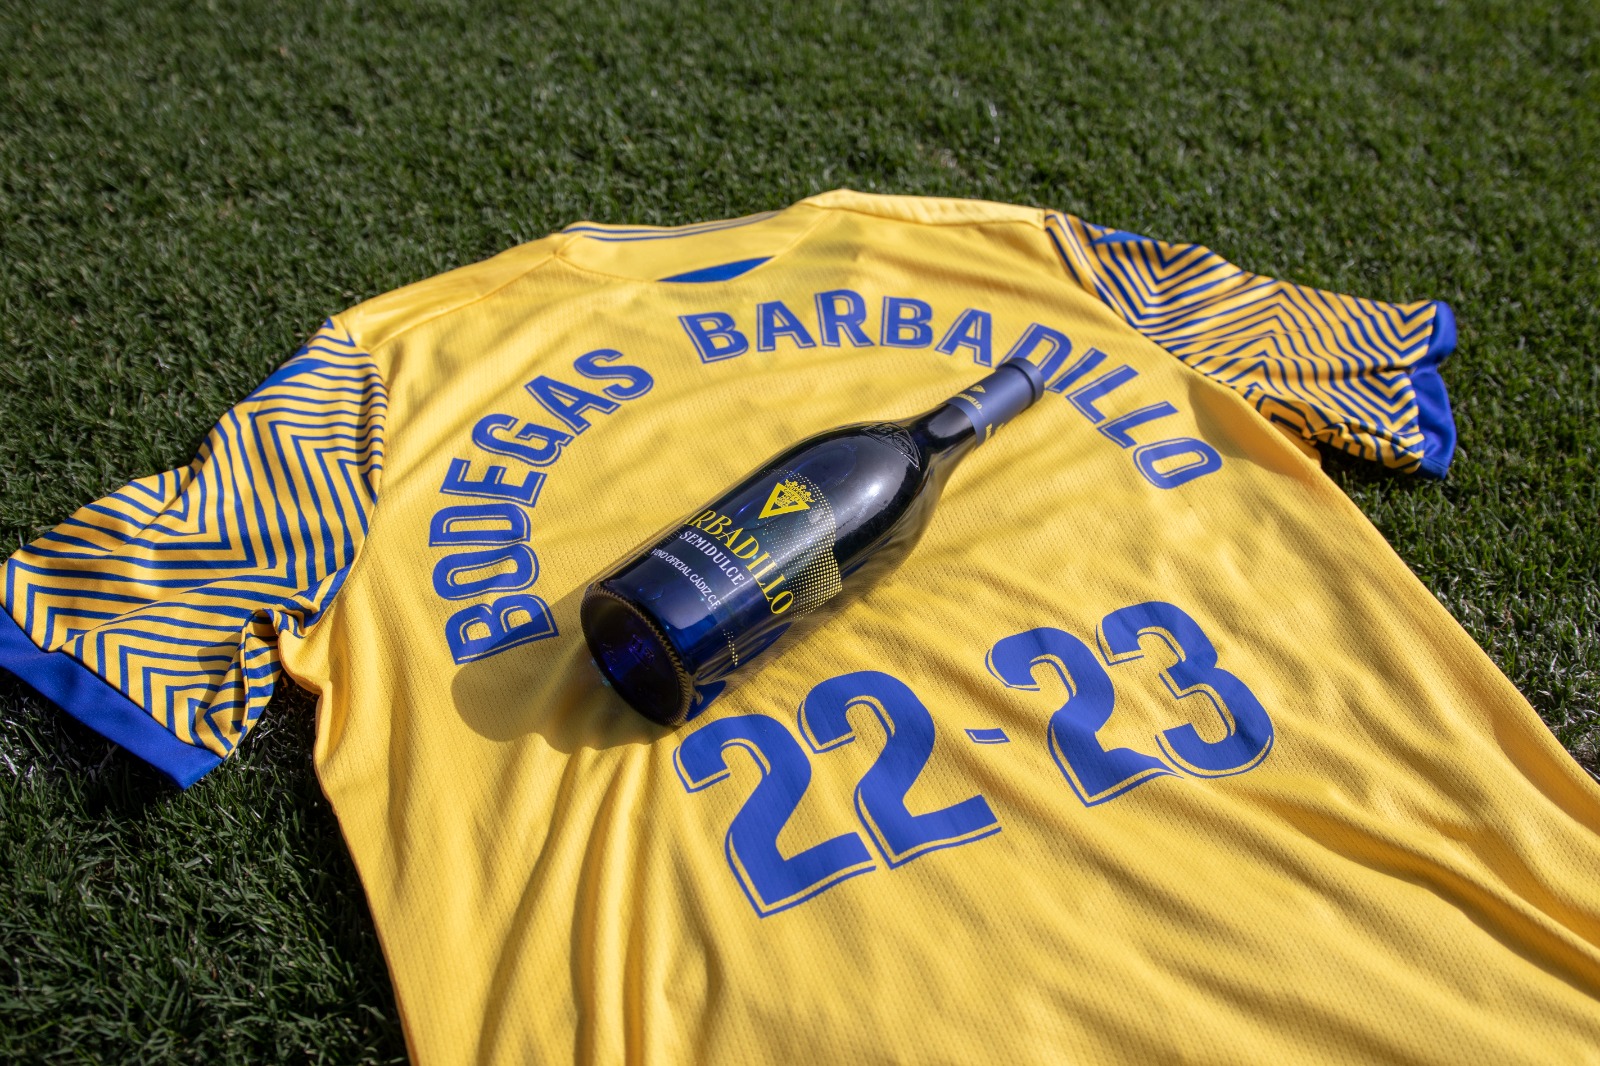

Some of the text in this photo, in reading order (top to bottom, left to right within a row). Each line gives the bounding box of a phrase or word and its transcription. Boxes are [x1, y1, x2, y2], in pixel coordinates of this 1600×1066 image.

[429, 289, 1223, 665] BODEGAS BARBADILLO
[651, 548, 721, 610] VINO OFICIAL CÁDIZ C.F.
[679, 530, 745, 586] SEMIDULCE
[684, 510, 794, 615] RBADILLO
